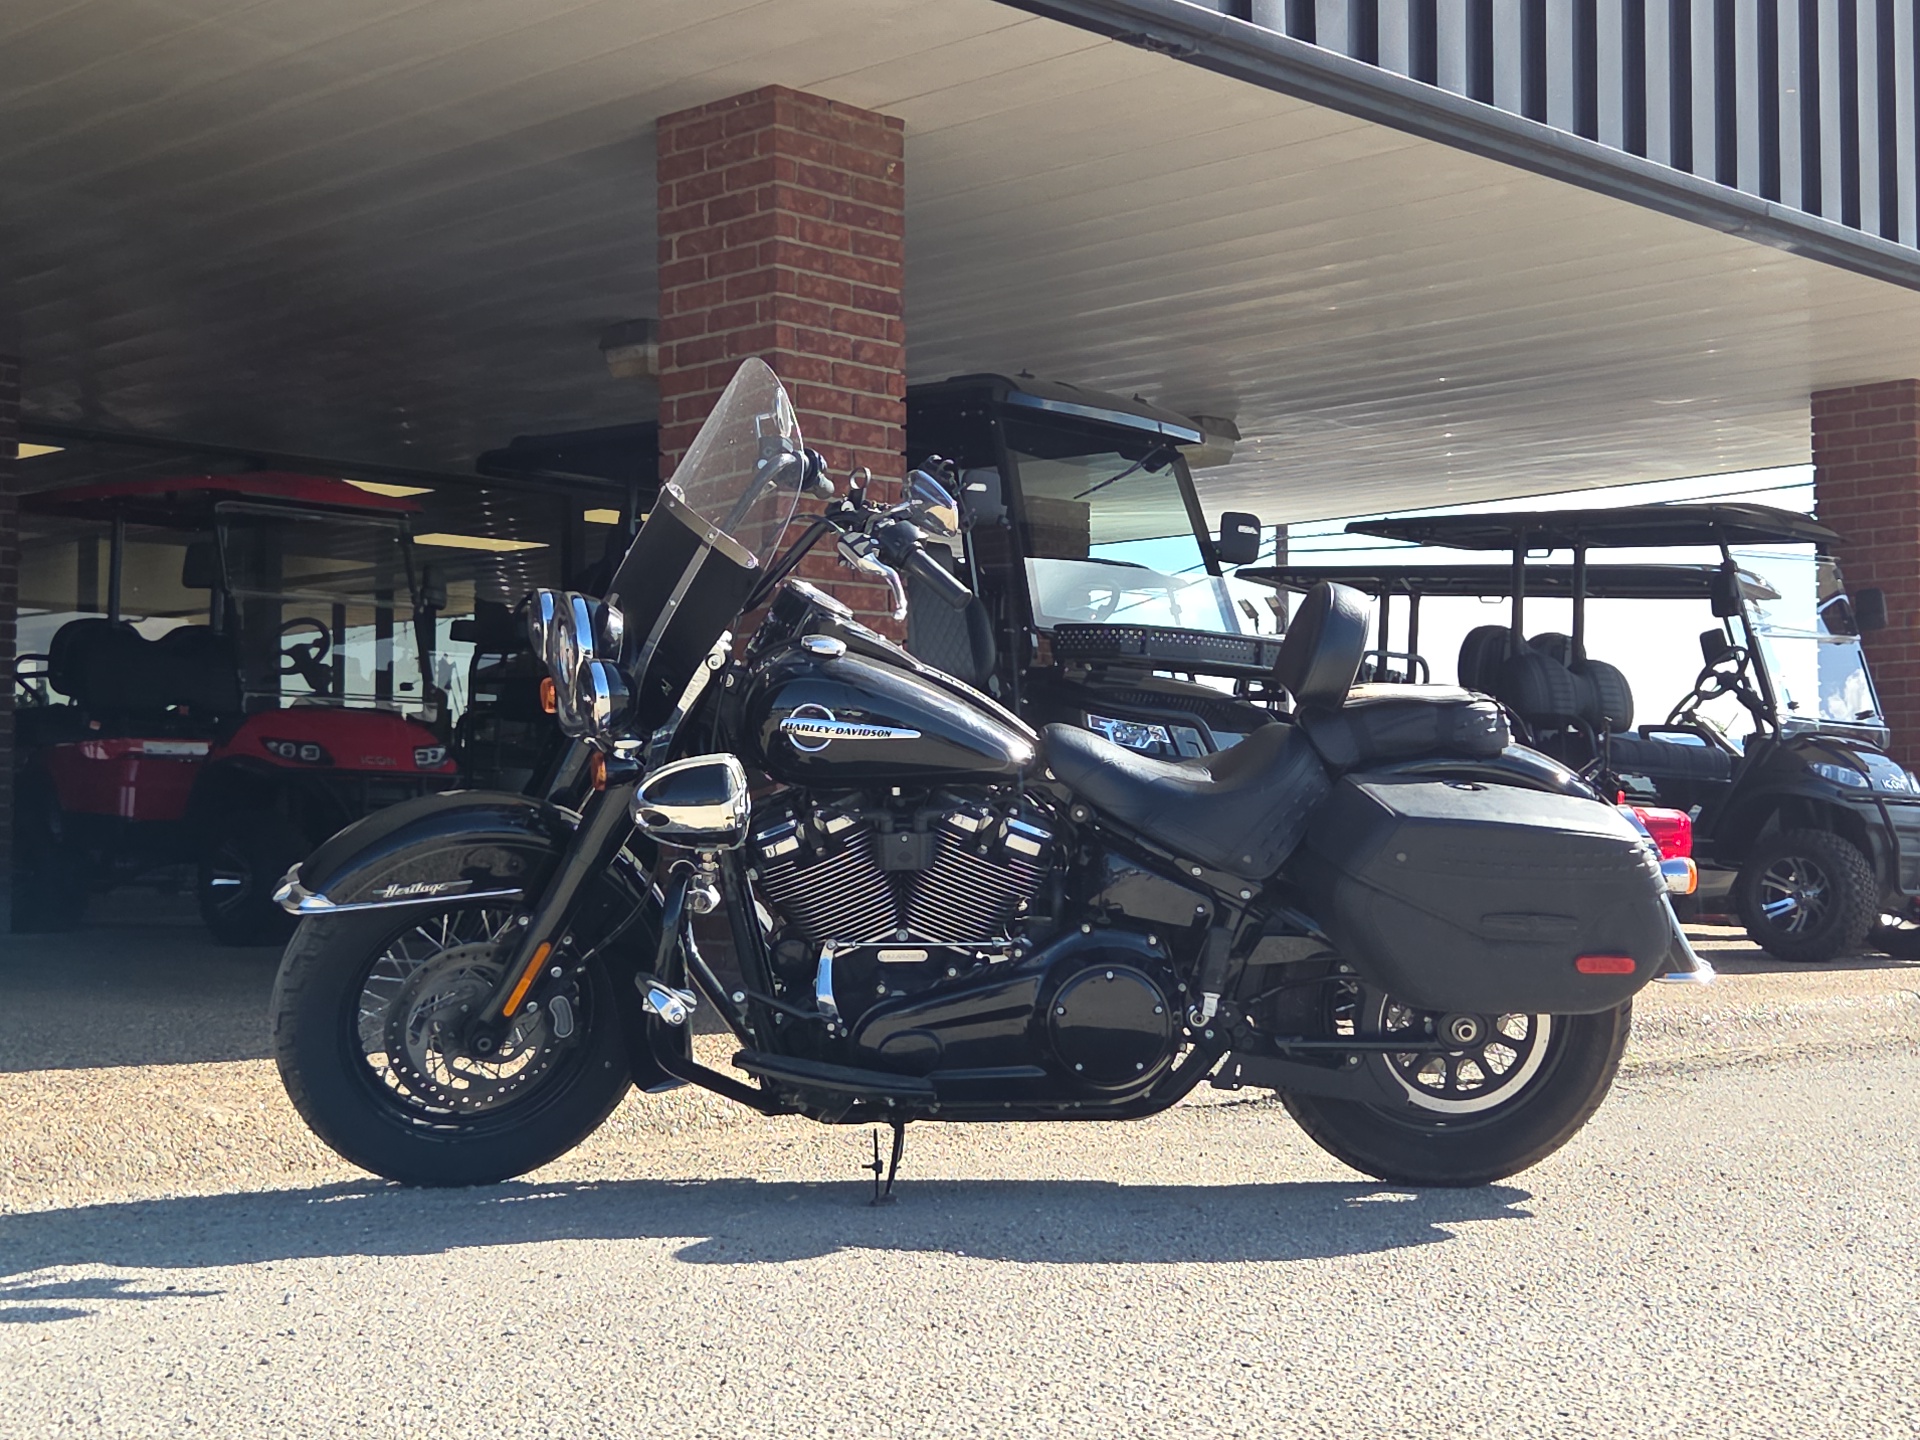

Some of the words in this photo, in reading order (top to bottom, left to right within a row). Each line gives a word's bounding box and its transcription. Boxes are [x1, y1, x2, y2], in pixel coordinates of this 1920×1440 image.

[785, 722, 892, 738] HARLEY-DAVIDSON
[1881, 779, 1905, 791] ICON
[383, 882, 448, 898] Heritage
